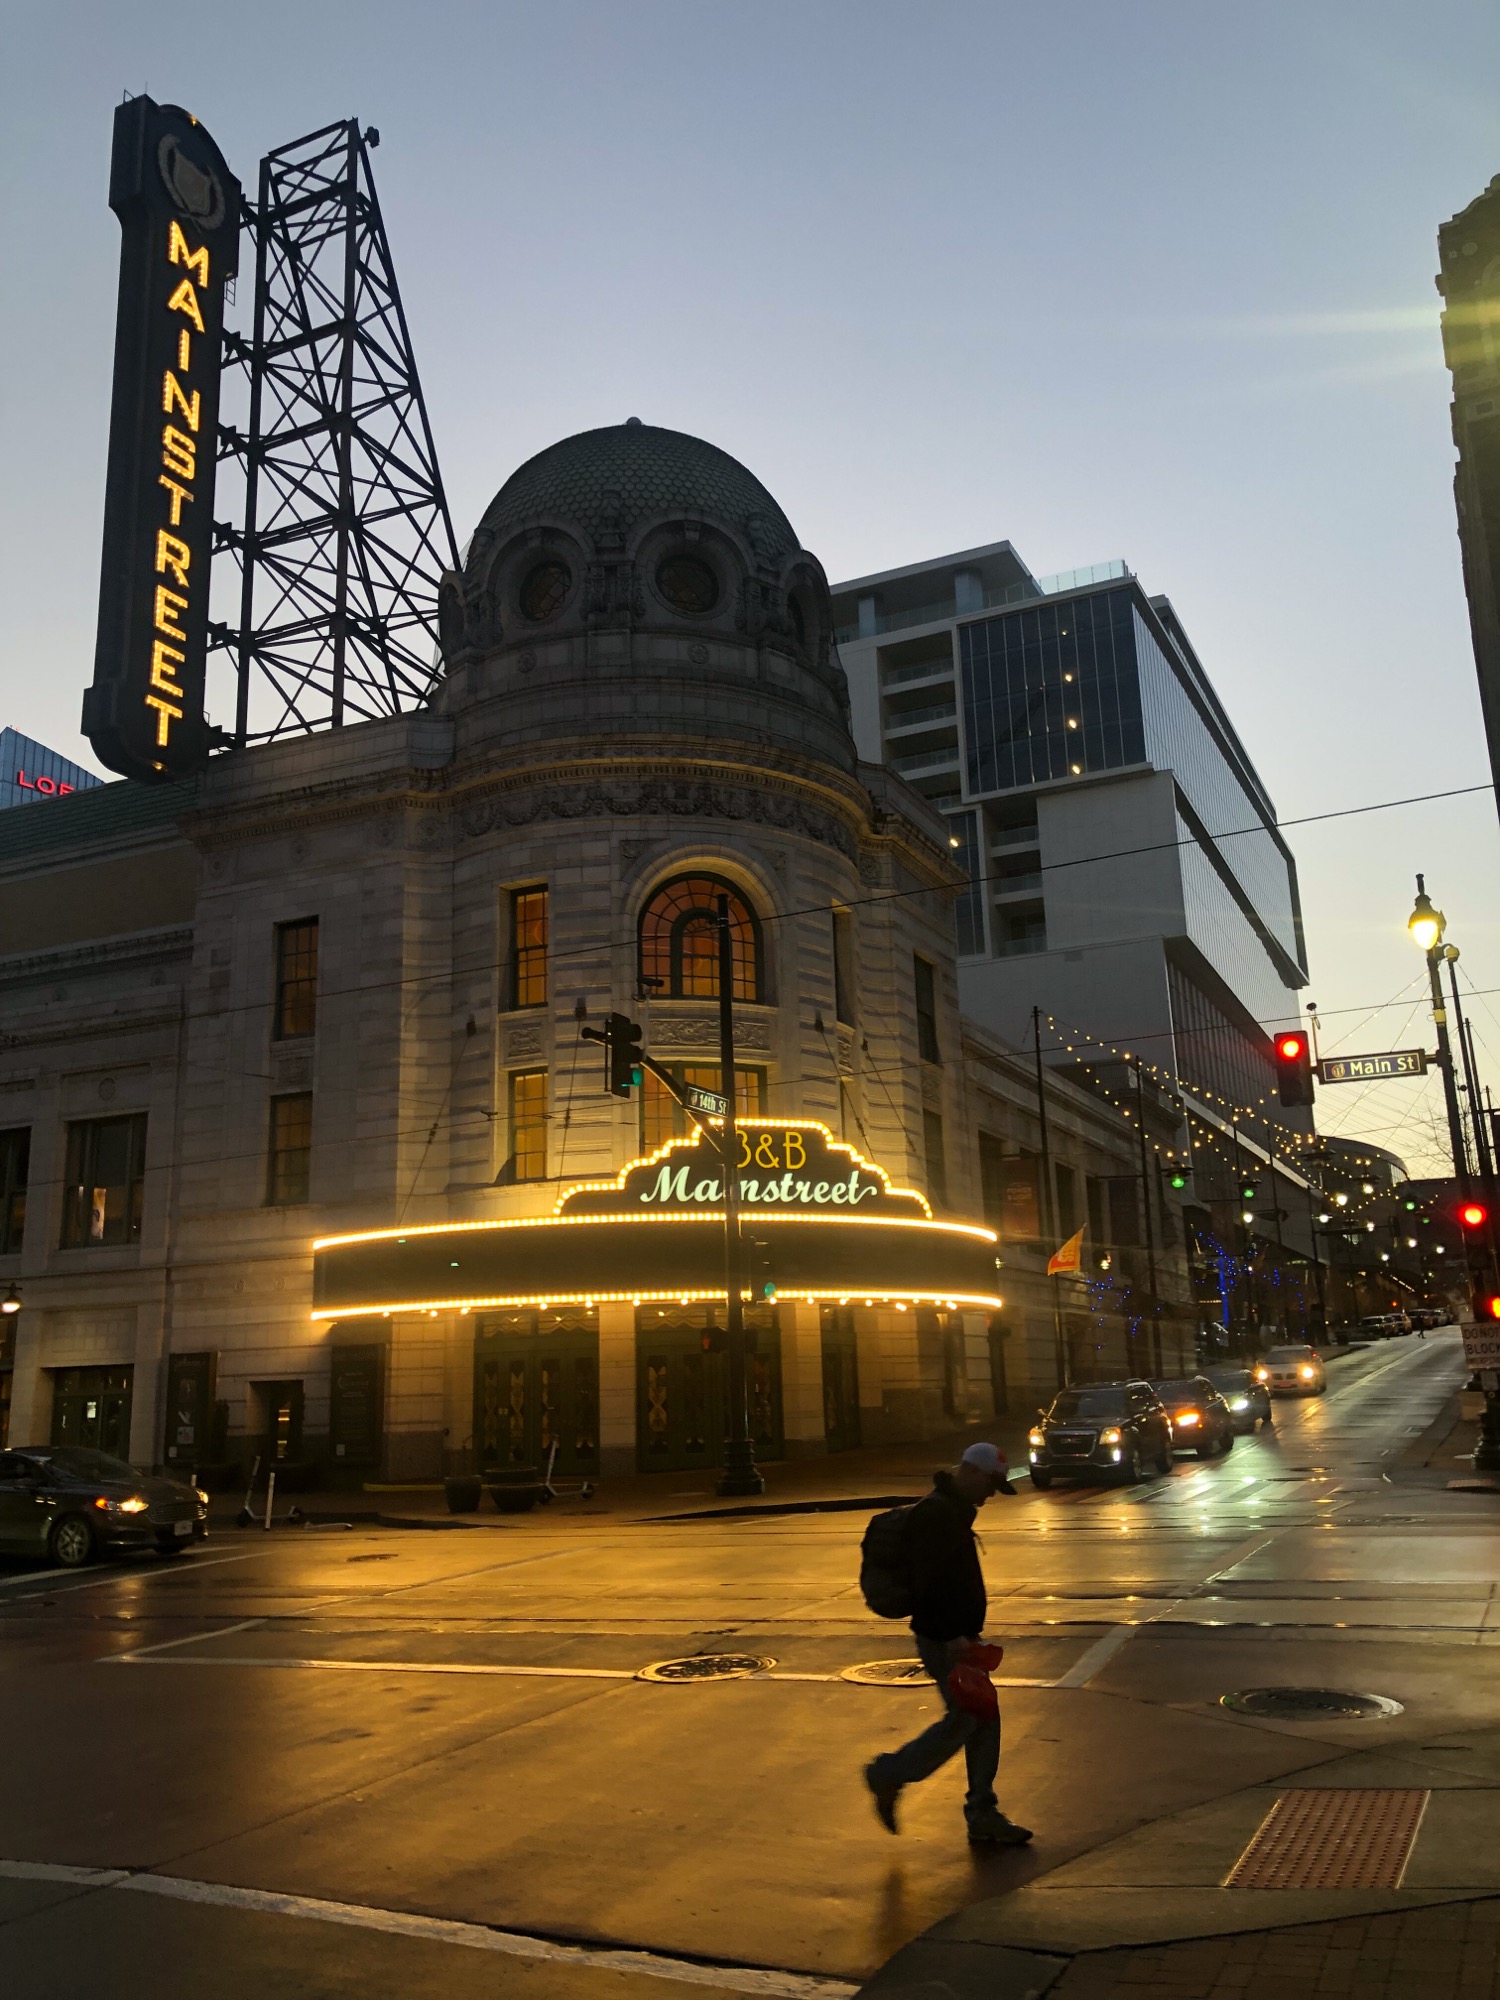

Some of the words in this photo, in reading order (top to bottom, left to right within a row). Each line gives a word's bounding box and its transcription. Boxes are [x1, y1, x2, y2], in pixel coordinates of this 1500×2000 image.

[145, 219, 209, 746] MAINSTREET
[1350, 1058, 1391, 1076] Main
[1397, 1056, 1415, 1071] St
[699, 1093, 716, 1111] 14th
[717, 1100, 727, 1115] St
[735, 1129, 807, 1170] B&B
[640, 1165, 878, 1205] Manstreet
[1463, 1328, 1478, 1339] DO
